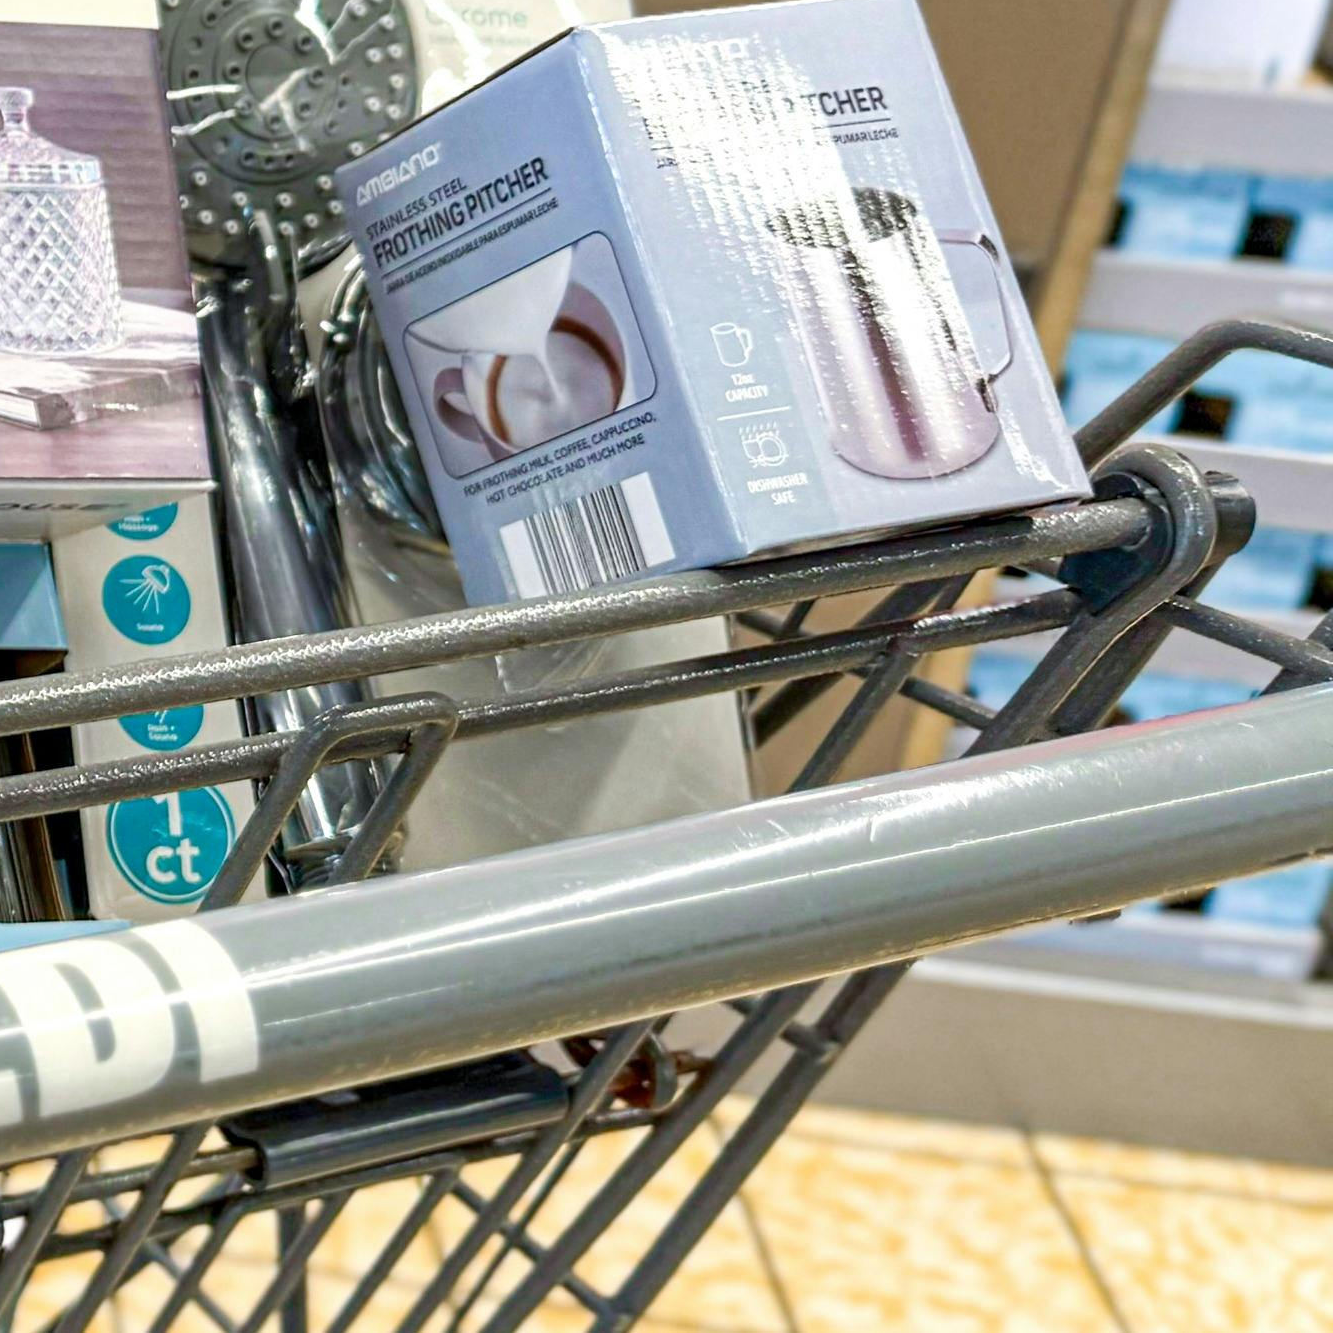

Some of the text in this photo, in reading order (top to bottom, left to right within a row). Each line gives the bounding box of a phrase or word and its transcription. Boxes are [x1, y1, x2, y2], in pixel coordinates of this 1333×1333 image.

[365, 176, 468, 243] STAINLESS STEEL
[372, 156, 550, 269] FROTHING PITCHER
[616, 432, 646, 455] MORE
[770, 489, 797, 507] SAFE
[151, 792, 184, 838] 1
[144, 837, 203, 886] ct
